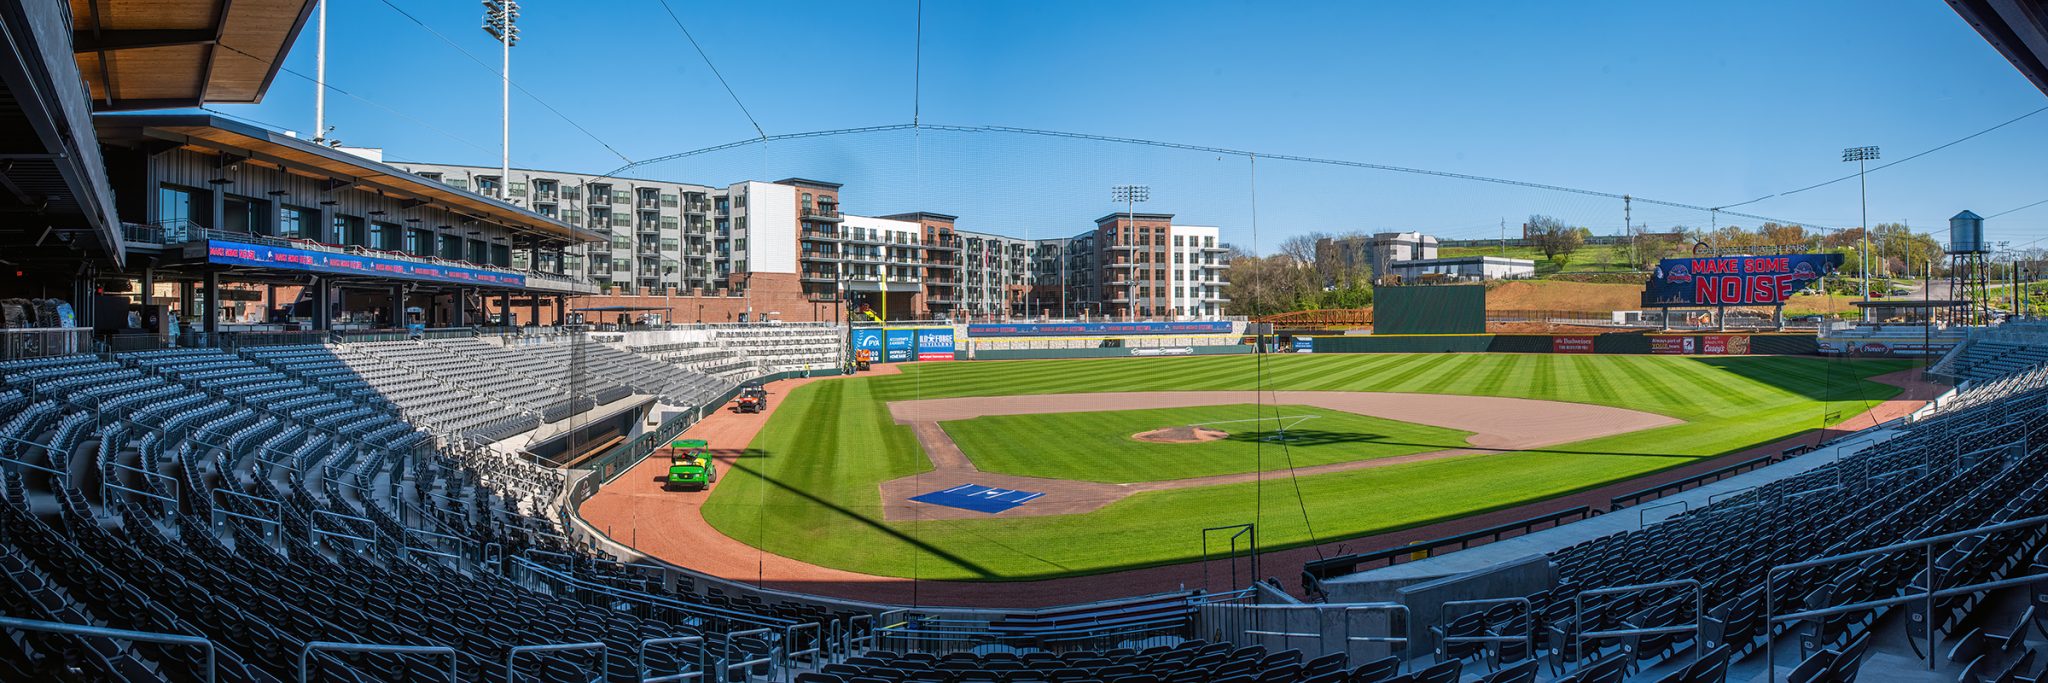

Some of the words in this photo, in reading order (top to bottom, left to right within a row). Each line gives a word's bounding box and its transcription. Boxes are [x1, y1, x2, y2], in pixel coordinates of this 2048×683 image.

[1692, 259, 1738, 274] MAKE
[1744, 258, 1790, 273] SOME
[1696, 274, 1794, 304] NOISE
